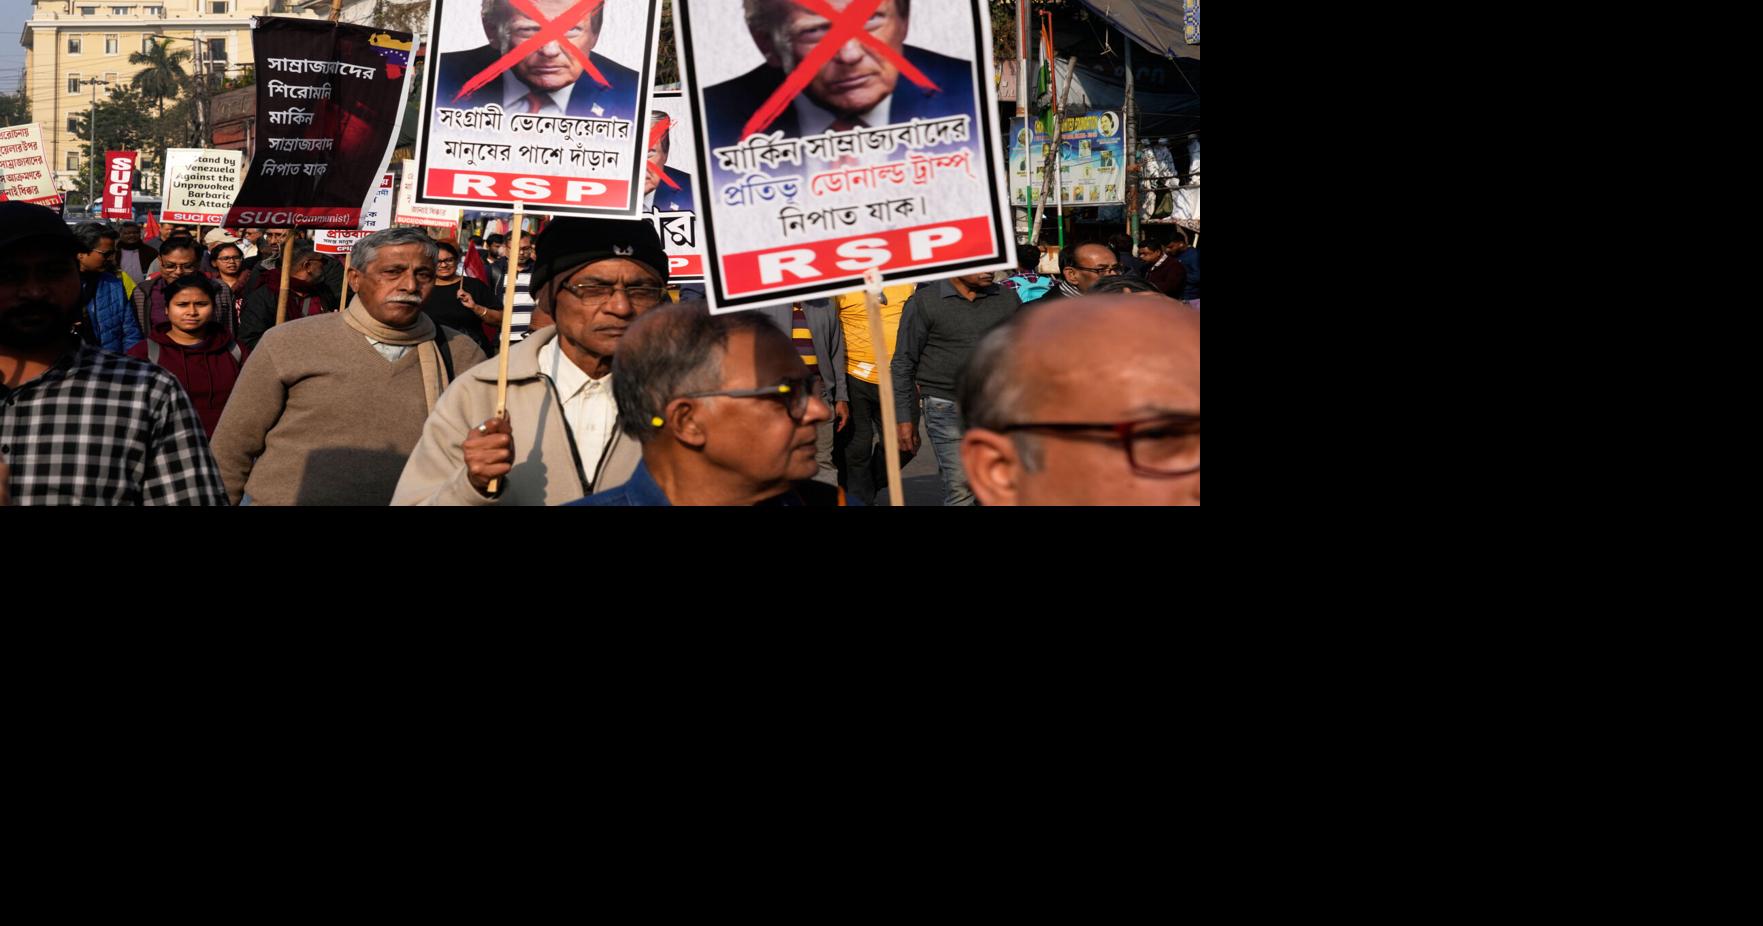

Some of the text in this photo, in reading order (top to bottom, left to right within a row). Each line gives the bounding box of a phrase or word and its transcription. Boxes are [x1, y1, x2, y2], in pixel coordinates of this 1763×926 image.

[267, 57, 376, 80] সাম্রাজ্যবাদের
[268, 107, 314, 126] মার্কিন
[439, 105, 629, 141] সংগ্রামী ভেনেজুয়েলার
[267, 137, 334, 152] সাম্রাজ্যবাদ
[717, 116, 969, 171] মার্কিন সাম্রাজ্যবাদের
[195, 156, 236, 166] tand by
[444, 140, 619, 171] মানুষের পাশে দাঁড়ান
[175, 172, 235, 183] Against the
[185, 164, 235, 174] Venezuela
[260, 159, 328, 177] নিপাত যাক
[109, 157, 132, 208] SUCI
[173, 181, 234, 191] Unprovoked
[452, 173, 608, 202] RSP
[811, 161, 906, 197] ডোনাল্ড
[181, 199, 196, 207] US
[188, 191, 231, 200] Barbaric
[173, 213, 204, 222] SUCI
[778, 204, 860, 238] নিপাত
[757, 226, 963, 286] RSP
